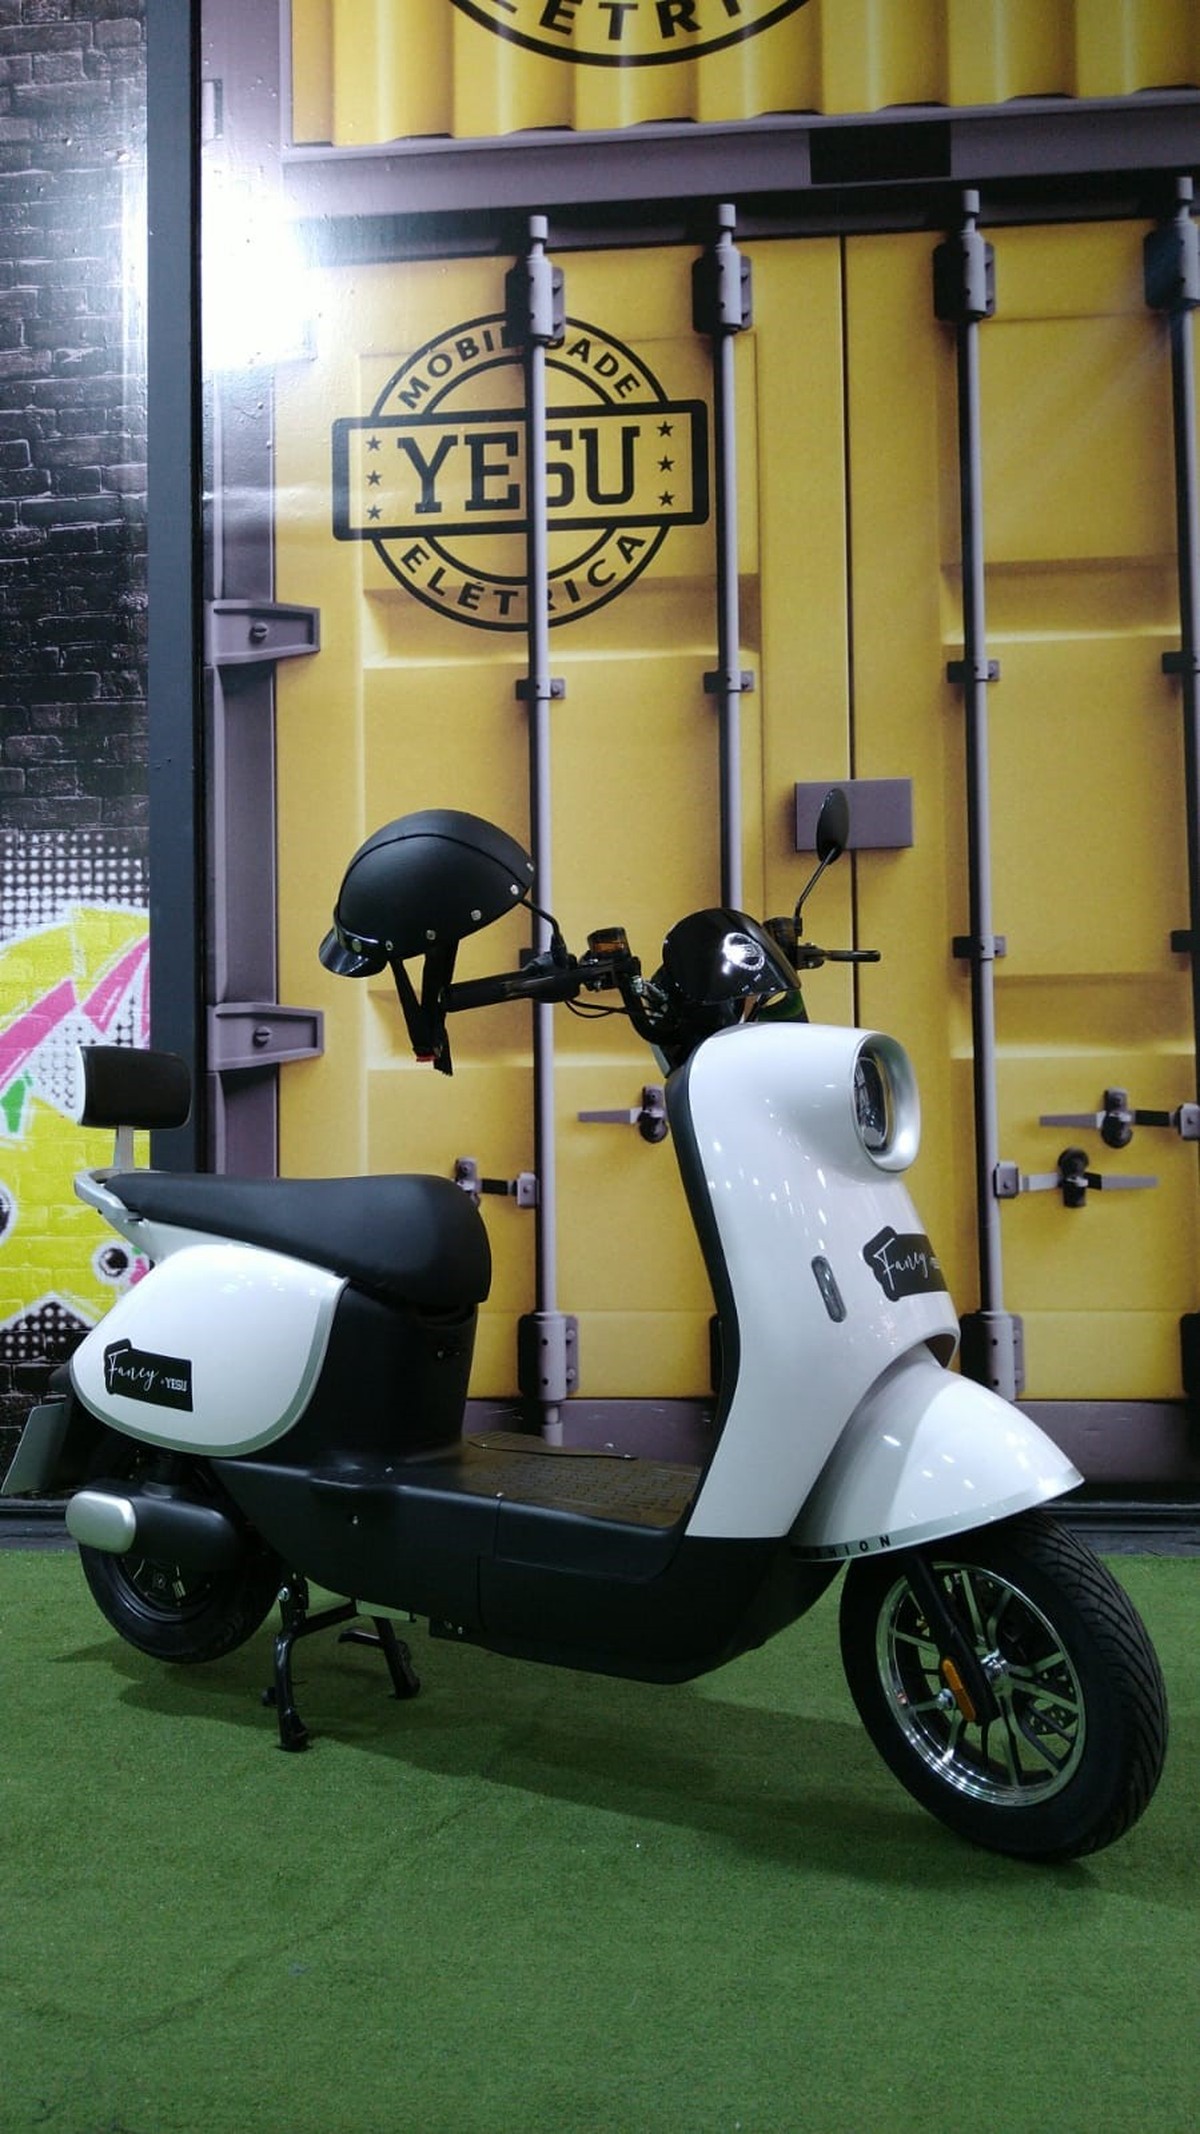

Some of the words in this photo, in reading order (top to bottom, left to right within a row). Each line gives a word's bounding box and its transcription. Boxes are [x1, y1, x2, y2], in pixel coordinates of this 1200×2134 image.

[397, 326, 641, 410] MOBIADE
[397, 426, 641, 514] YESU
[873, 1237, 929, 1291] Fancy
[108, 1348, 160, 1392] Fancy
